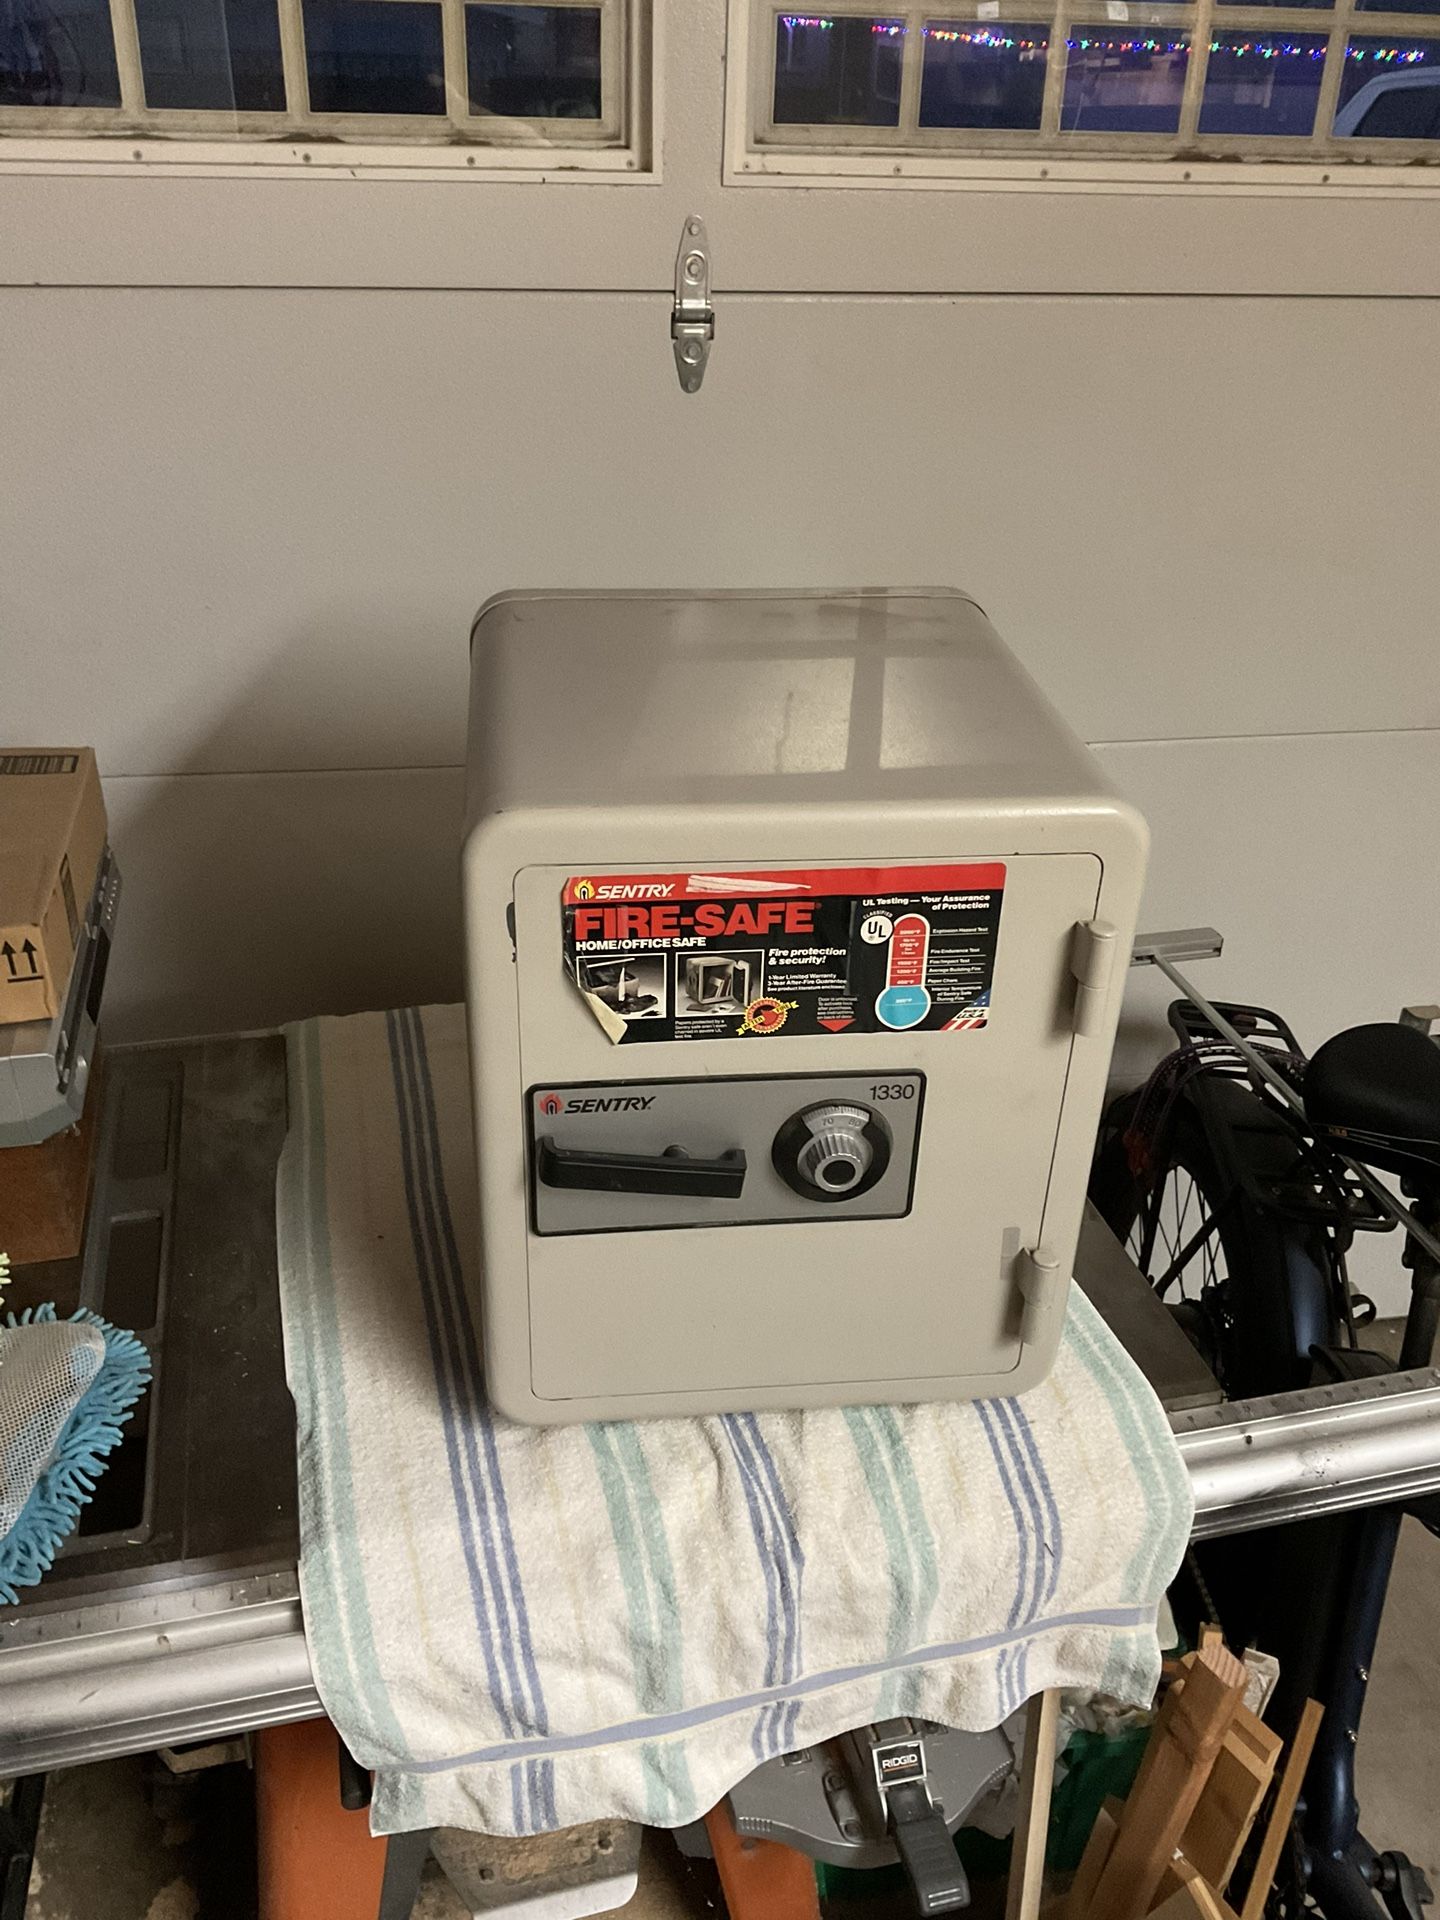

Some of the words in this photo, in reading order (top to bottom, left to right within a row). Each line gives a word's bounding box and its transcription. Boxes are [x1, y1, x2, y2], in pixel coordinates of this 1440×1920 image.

[595, 884, 676, 900] SENTRY
[862, 899, 876, 907] UL
[876, 897, 909, 906] Testing
[921, 895, 942, 903] Your
[942, 894, 991, 903] Assurance
[931, 902, 941, 911] of
[942, 902, 990, 910] Protection
[575, 902, 815, 940] FIRE-SAFE
[576, 938, 671, 952] HOME/OFFICE
[672, 937, 706, 948] SAFE
[768, 948, 790, 957] Fire
[790, 947, 847, 957] protection
[768, 957, 777, 965] &
[779, 956, 827, 965] security!
[869, 1083, 914, 1101] 1330
[564, 1096, 656, 1114] SENTRY
[821, 1117, 834, 1126] 70
[881, 1754, 918, 1769] RIDGID
